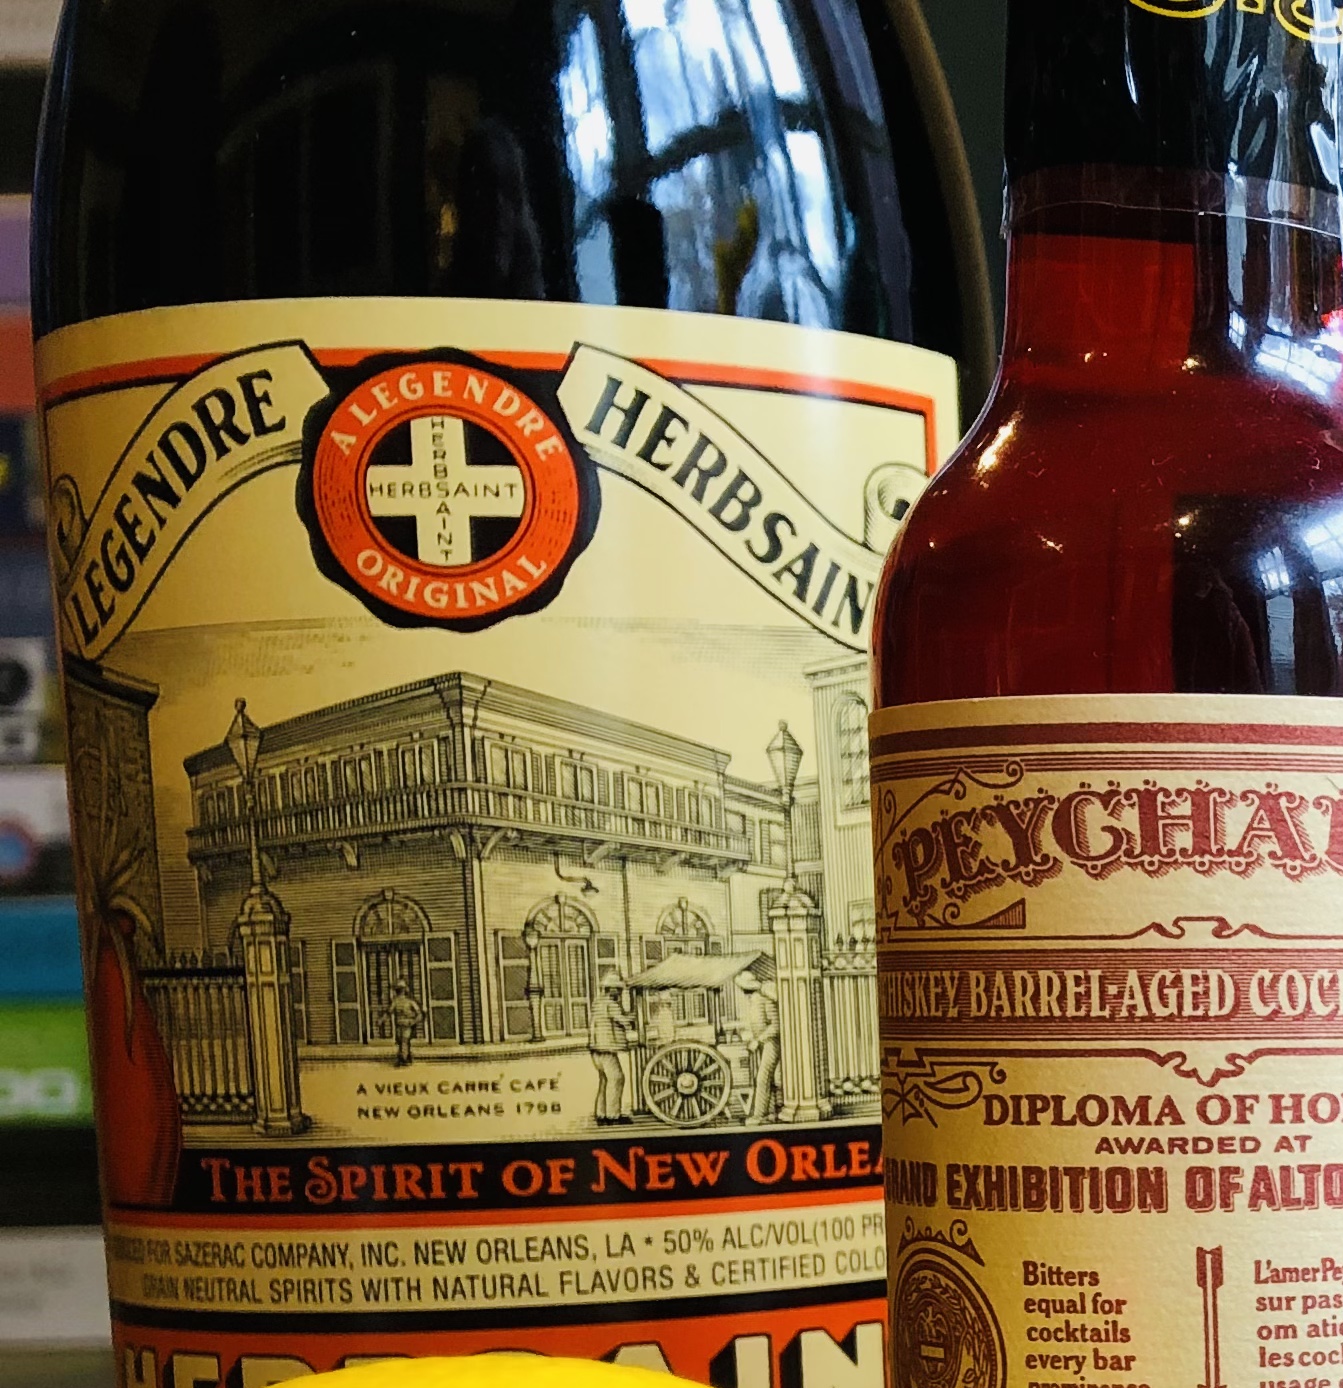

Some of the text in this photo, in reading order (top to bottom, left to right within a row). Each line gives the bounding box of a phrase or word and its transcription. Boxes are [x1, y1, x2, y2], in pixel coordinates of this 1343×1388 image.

[331, 370, 563, 461] A LEGENDRE
[369, 481, 519, 500] HERBSAINT
[586, 375, 871, 631] HERBSAIN
[72, 369, 288, 645] LEGENDRE
[356, 548, 547, 609] ORIGINAL
[969, 968, 1236, 1019] BARREL-AGED
[356, 1083, 367, 1096] A
[375, 1082, 429, 1096] VIEUX
[357, 1105, 400, 1119] NEW
[407, 1103, 505, 1121] ORLEANS
[982, 1093, 1186, 1128] DIPLOMA
[1196, 1093, 1260, 1126] OF
[1095, 1134, 1313, 1155] AWARDED AT
[202, 1138, 884, 1205] THE SPIRIT OF NEW ORLE
[945, 1163, 1170, 1214] EXHIBITION
[1185, 1165, 1244, 1214] OF
[175, 1240, 245, 1269] SAZERAC
[250, 1241, 355, 1272] COMPANY,
[361, 1243, 406, 1269] INC.
[413, 1239, 467, 1268] NEW
[476, 1233, 598, 1265] ORLEANS,
[605, 1231, 636, 1260] LA
[663, 1228, 715, 1255] 50%
[183, 1276, 263, 1304] NEUTRAL
[268, 1278, 353, 1304] SPIRITS
[360, 1277, 422, 1303] WITH
[432, 1270, 550, 1302] NATURAL
[559, 1264, 675, 1297] FLAVORS
[684, 1264, 701, 1289] &
[711, 1252, 826, 1287] CERTIFIED
[835, 1245, 885, 1276] COLO
[1022, 1260, 1100, 1287] Bitters
[1023, 1291, 1128, 1318] equal for
[1255, 1295, 1297, 1312] sur
[1026, 1319, 1132, 1344] cocktails
[1256, 1323, 1298, 1341] om
[1025, 1347, 1137, 1376] every bar
[1258, 1346, 1295, 1368] les
